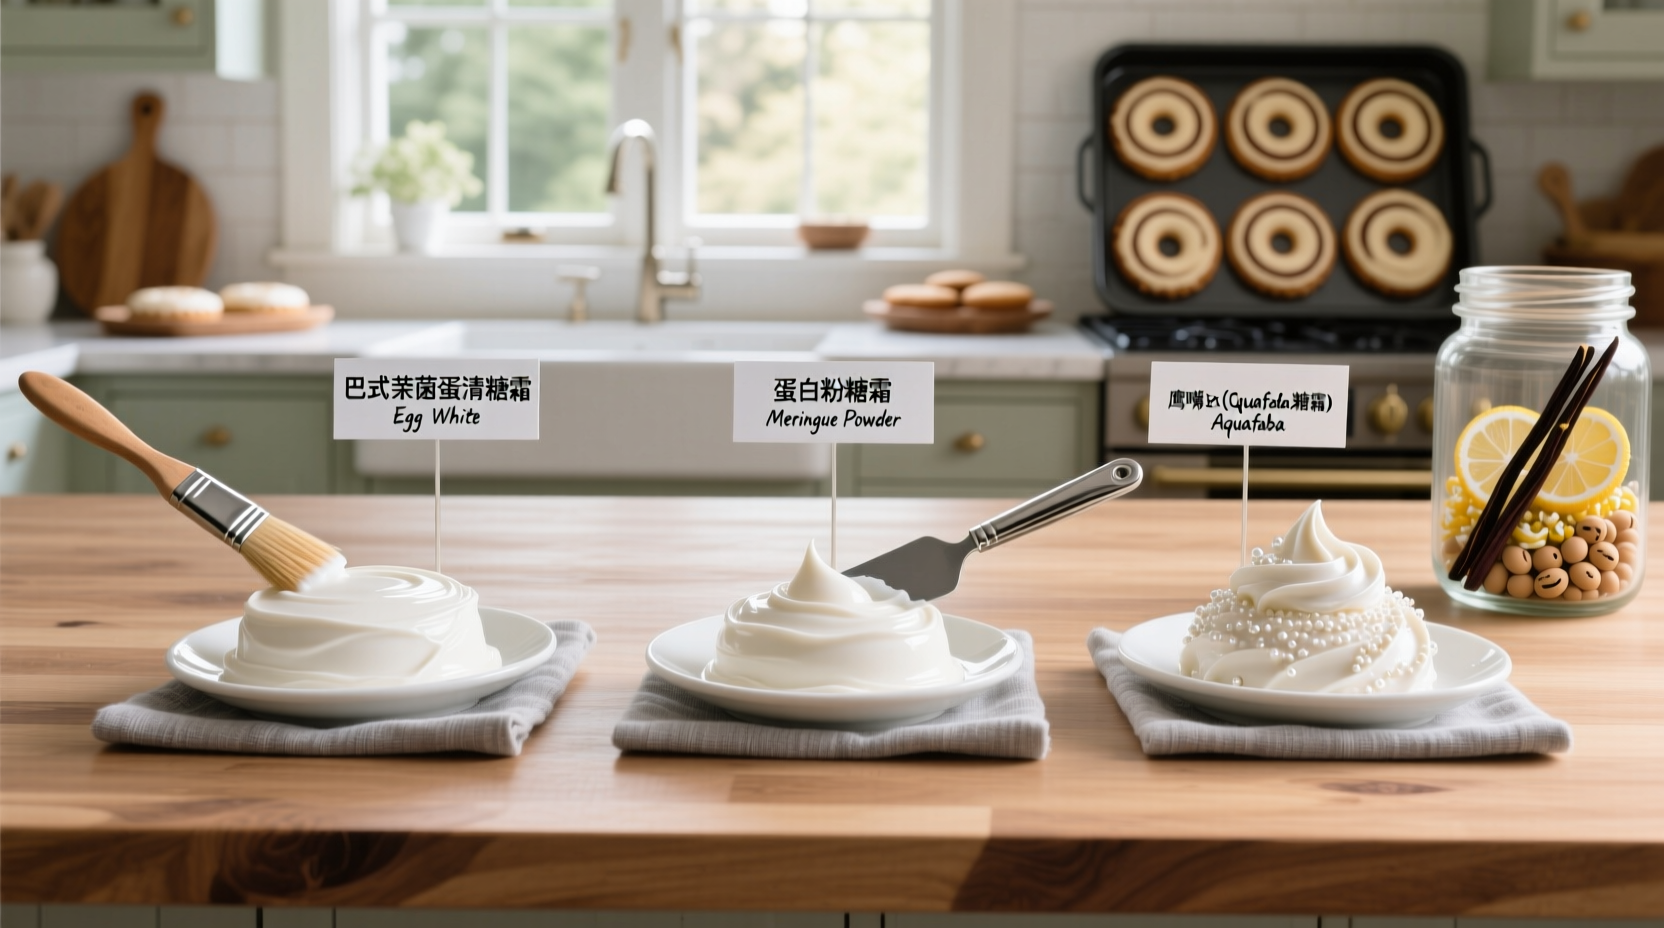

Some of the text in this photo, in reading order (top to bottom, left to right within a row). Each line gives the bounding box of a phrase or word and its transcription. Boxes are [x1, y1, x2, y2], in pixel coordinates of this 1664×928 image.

[773, 376, 892, 404] 蛋白粉糖霜
[392, 405, 481, 434] Egg White
[765, 408, 902, 436] Meringue Powder
[1210, 412, 1286, 439] Aquafaba
